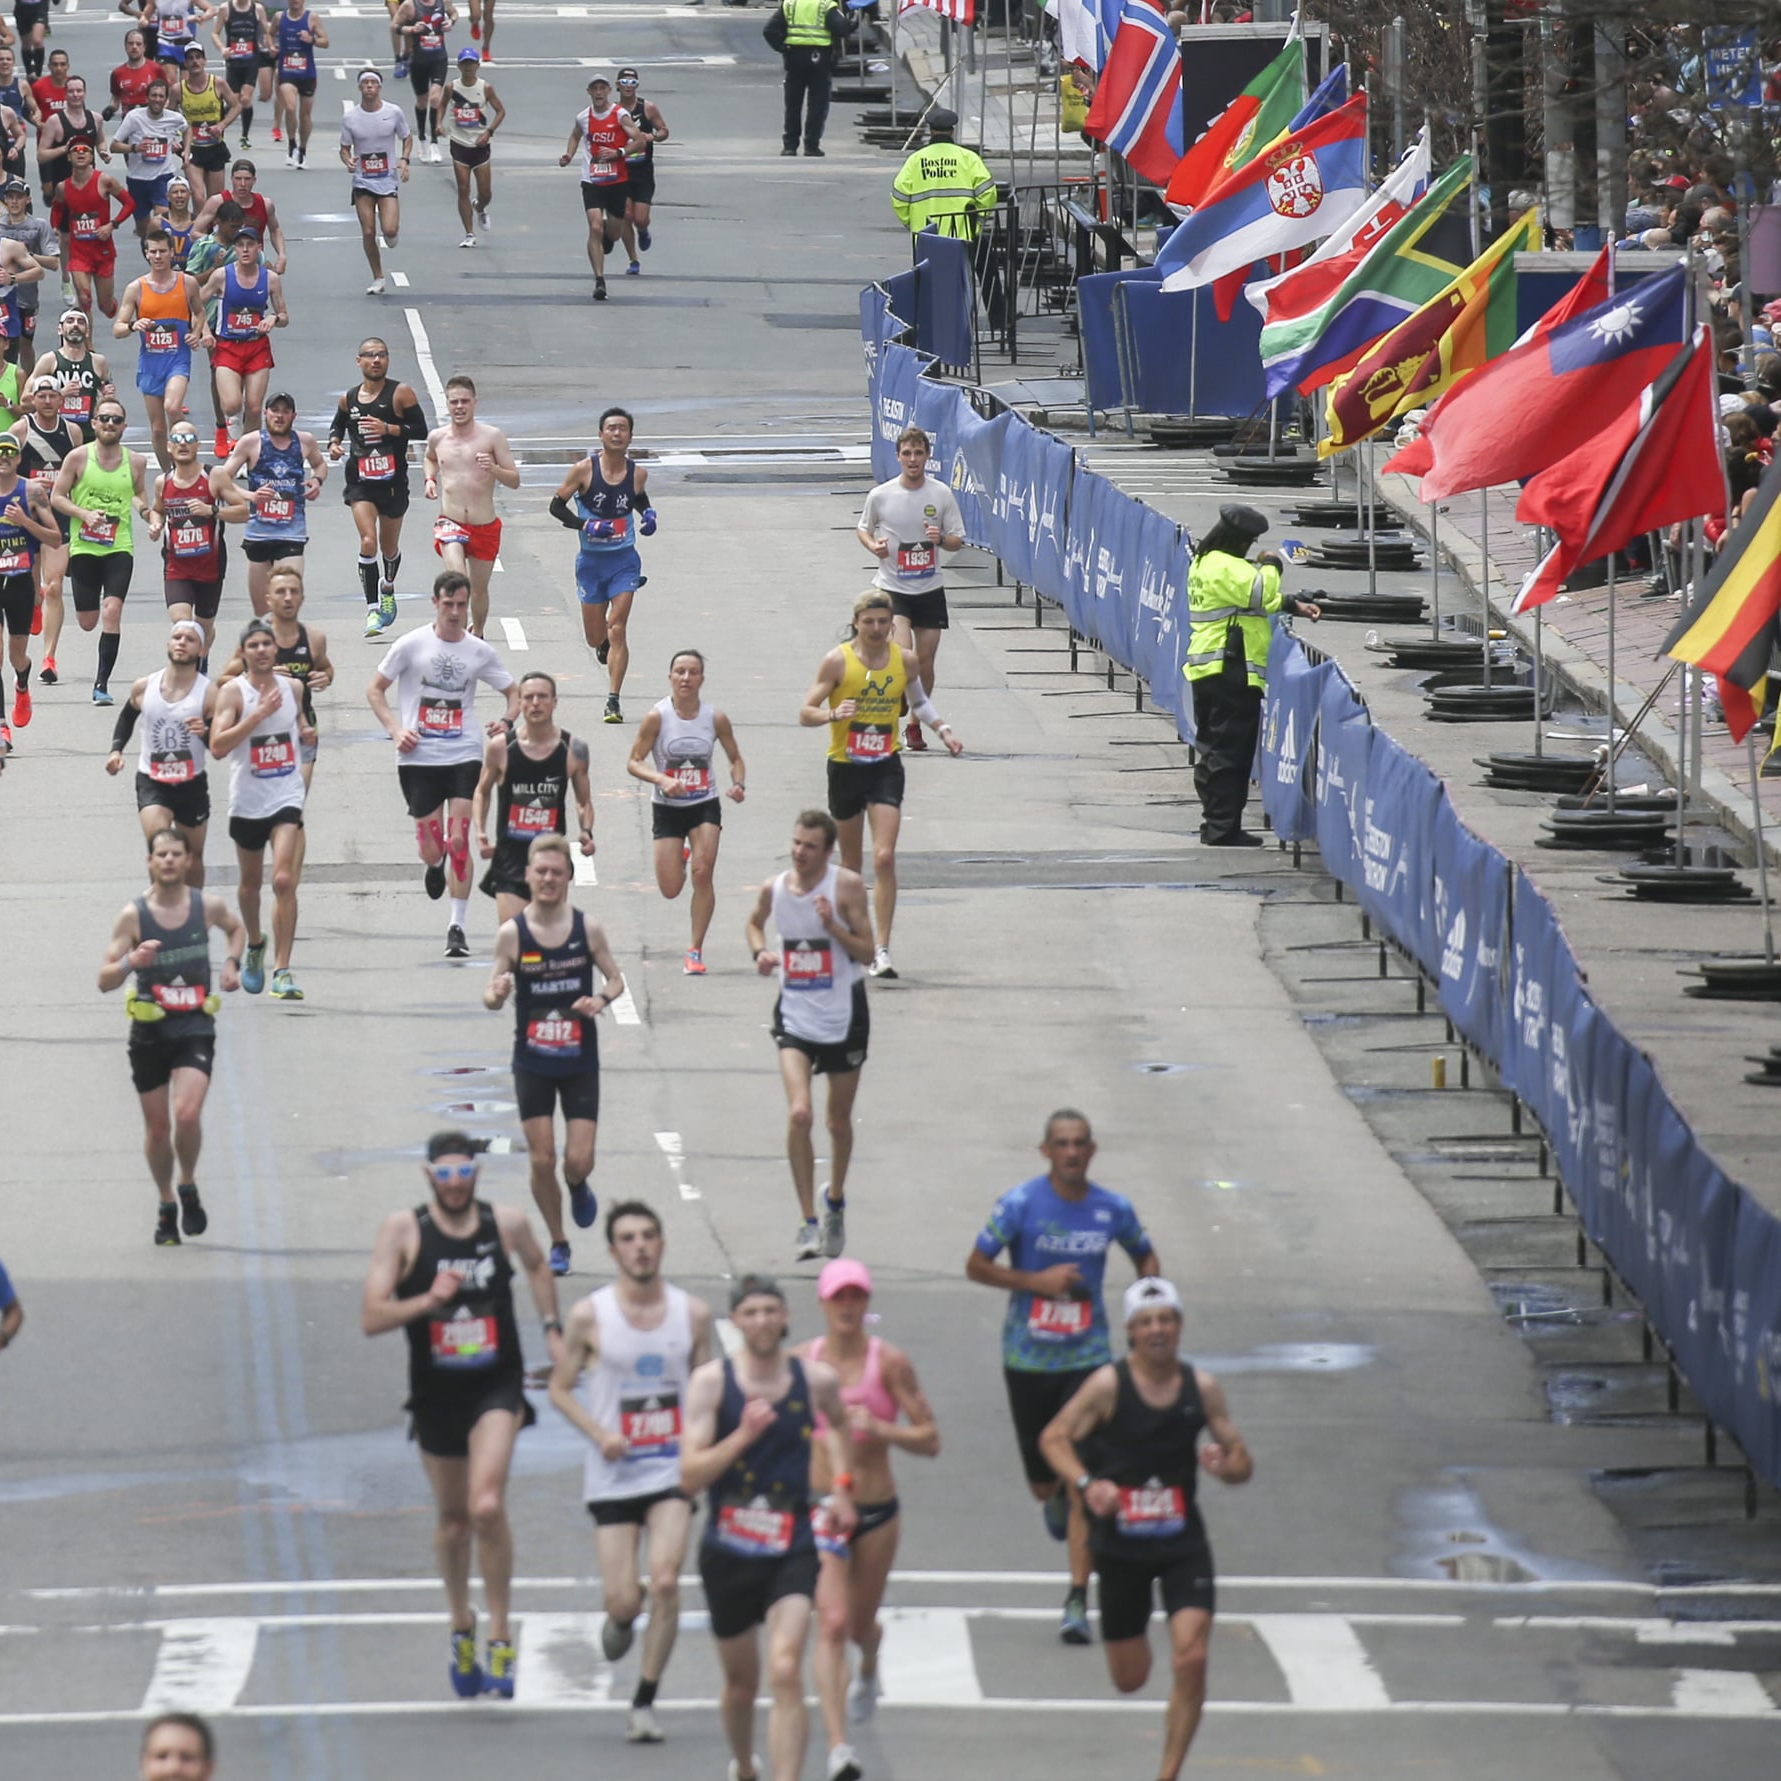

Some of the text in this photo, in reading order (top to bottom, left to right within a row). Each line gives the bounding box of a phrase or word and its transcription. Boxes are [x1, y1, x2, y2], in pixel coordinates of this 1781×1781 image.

[591, 132, 615, 143] CSU
[920, 157, 958, 169] Boston
[920, 167, 958, 180] Police
[77, 220, 96, 231] 1212
[235, 314, 253, 326] 745
[150, 332, 173, 345] 2125
[56, 370, 94, 390] NAC
[176, 530, 202, 546] 2676
[904, 551, 930, 567] 1935
[854, 729, 888, 750] 1425
[535, 780, 559, 797] CITY
[530, 977, 581, 995] MARTIN
